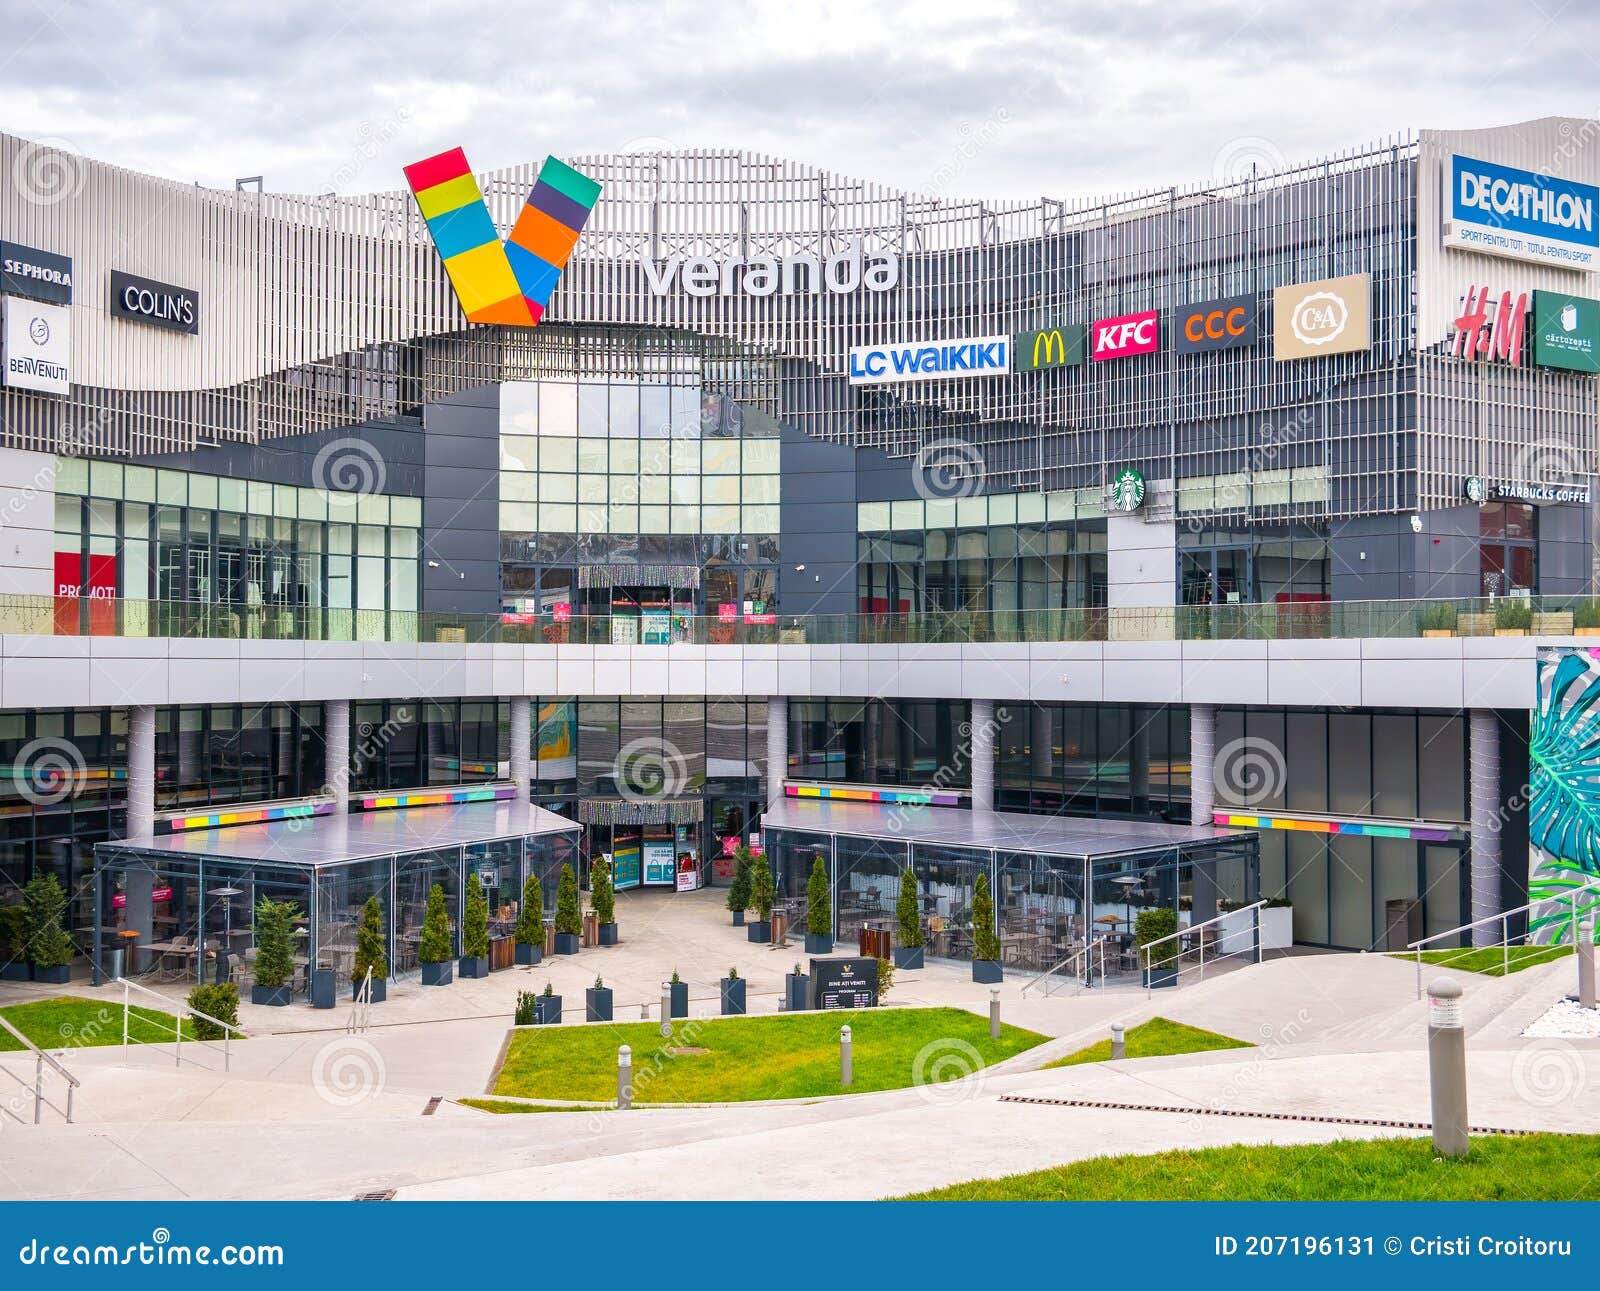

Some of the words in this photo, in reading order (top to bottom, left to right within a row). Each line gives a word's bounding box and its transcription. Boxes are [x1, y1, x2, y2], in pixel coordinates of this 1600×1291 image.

[1461, 170, 1592, 232] DECATHLON
[1461, 229, 1482, 241] SPORT
[1483, 233, 1509, 247] PENTRU
[1527, 242, 1547, 255] TOTUL
[1547, 246, 1572, 260] PENTRU
[1572, 251, 1592, 263] SPORT
[4, 259, 72, 287] SEPHORA
[641, 235, 899, 297] veranda
[125, 286, 193, 324] COLIN'S
[1301, 304, 1338, 331] C&A
[1095, 319, 1153, 353] KFC
[1185, 306, 1246, 342] CCC
[1451, 284, 1527, 368] H&M
[10, 356, 68, 381] BENVENUTI
[850, 351, 886, 377] LC
[1498, 485, 1554, 501] STARBUCKS
[1556, 490, 1590, 503] COFFEE
